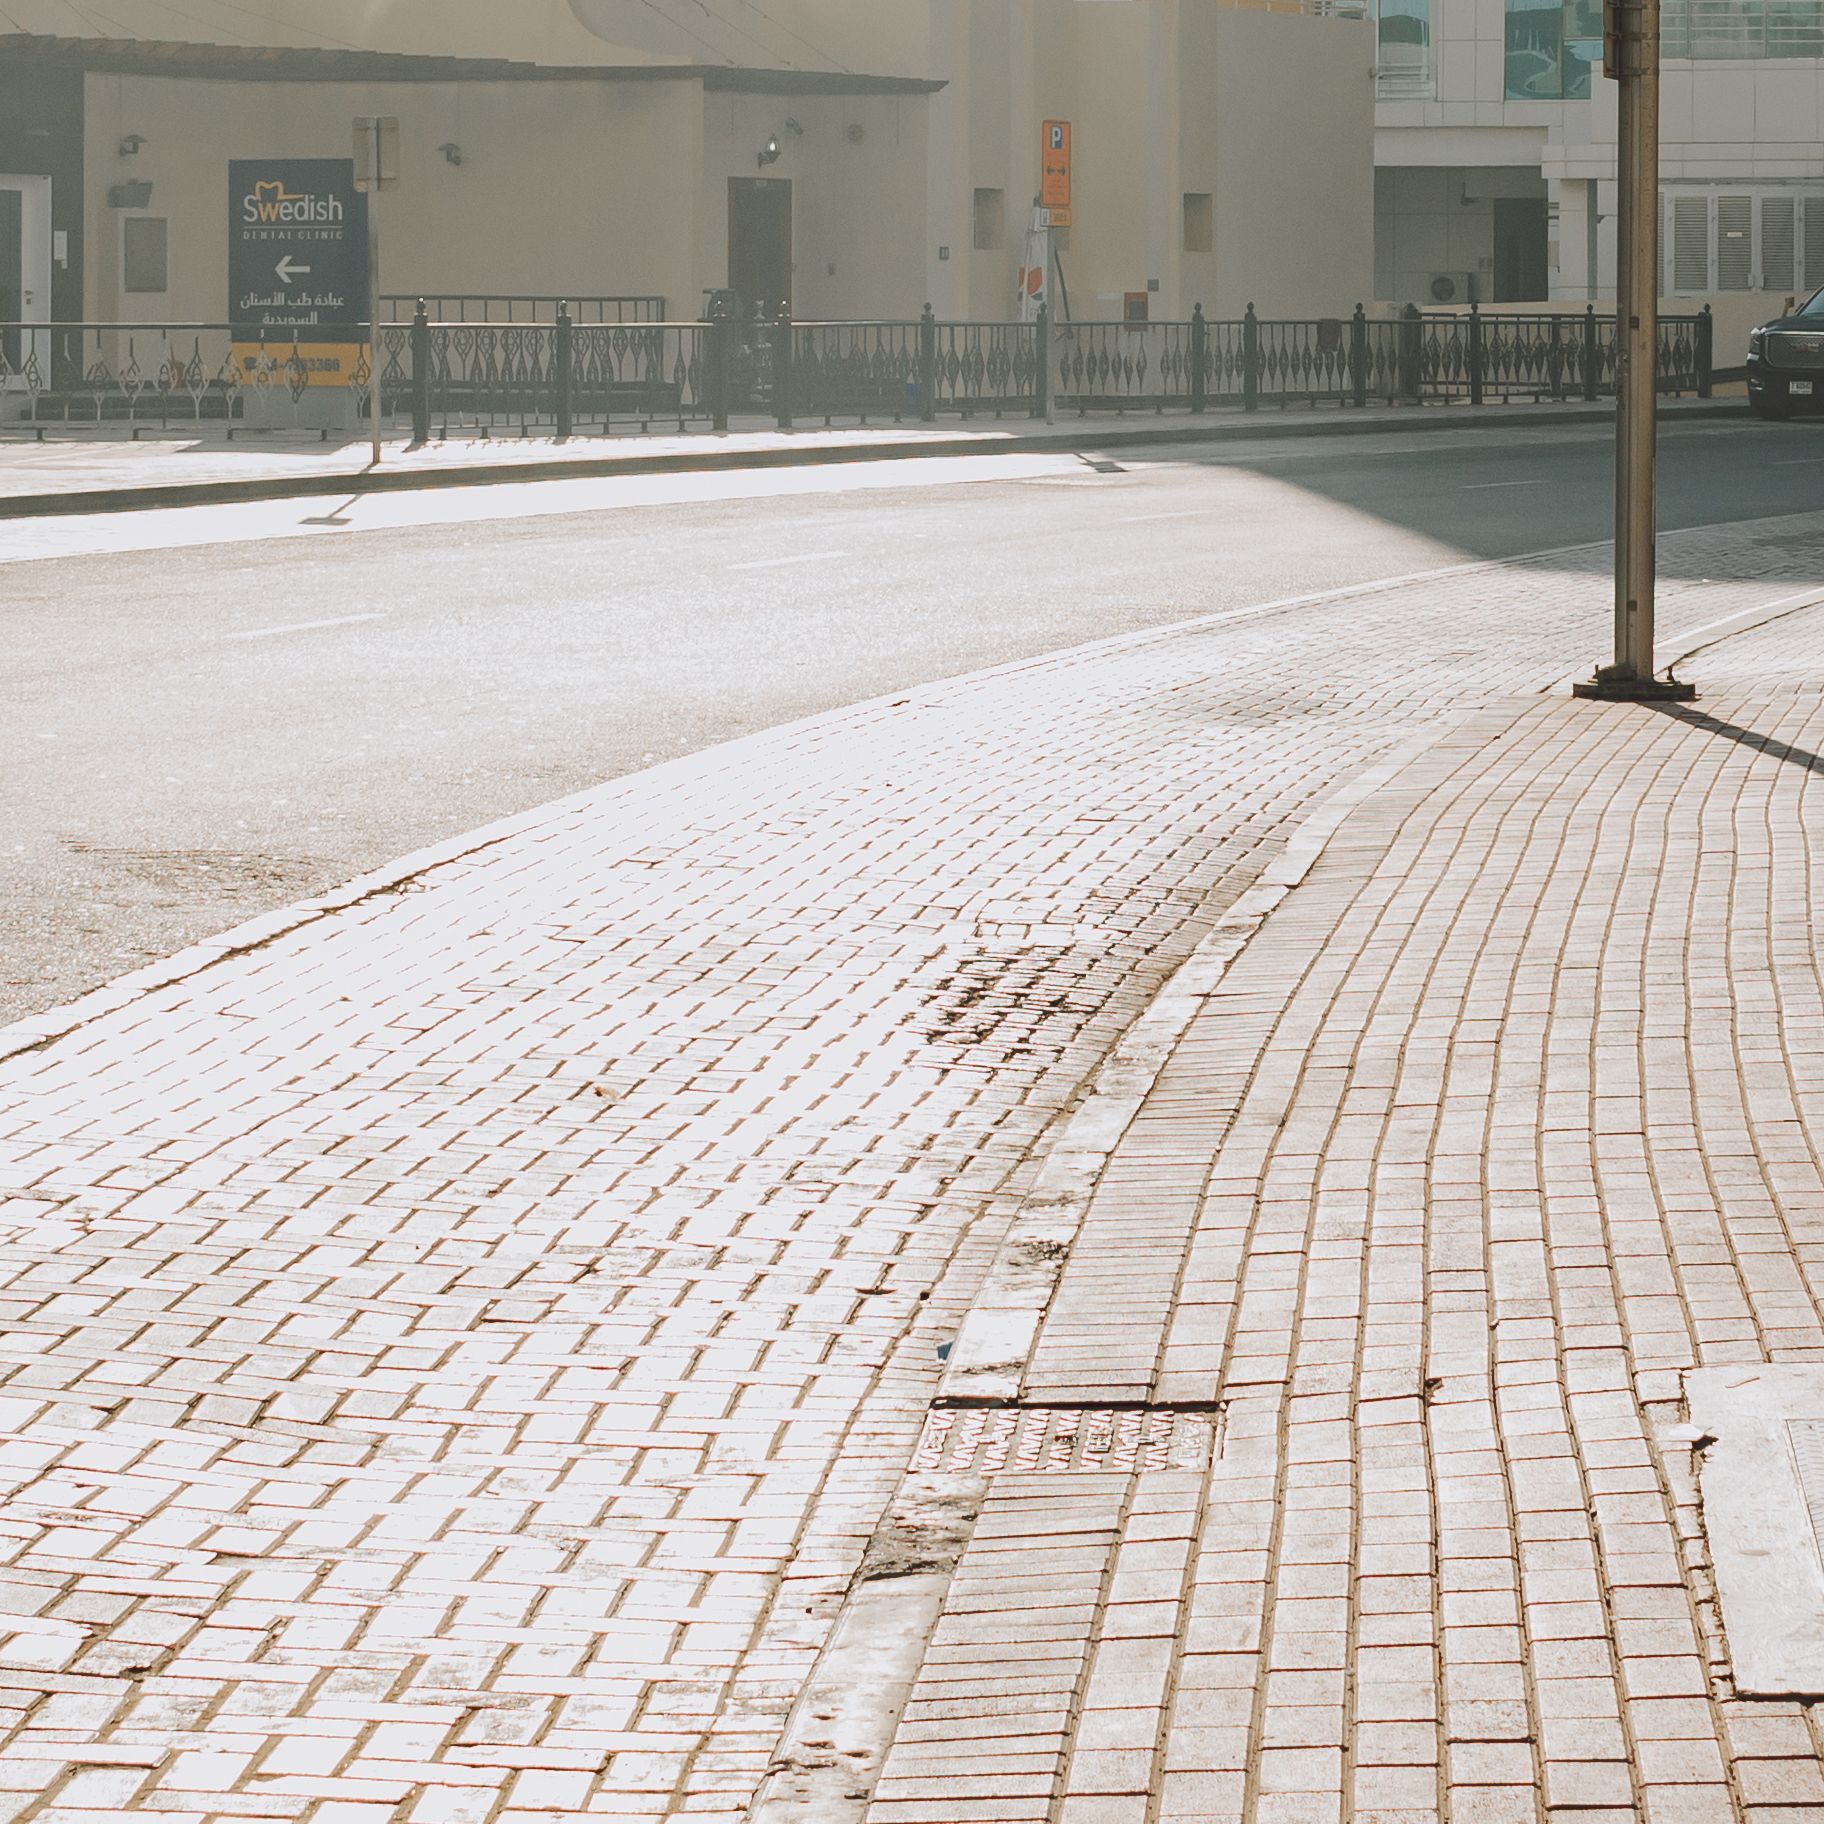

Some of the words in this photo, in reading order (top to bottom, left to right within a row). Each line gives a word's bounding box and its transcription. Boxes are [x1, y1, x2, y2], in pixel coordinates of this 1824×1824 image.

[1051, 126, 1062, 148] P
[242, 192, 343, 223] Swedish
[298, 230, 344, 240] CLINIC
[287, 291, 313, 307] طب
[314, 291, 345, 308] عيادة
